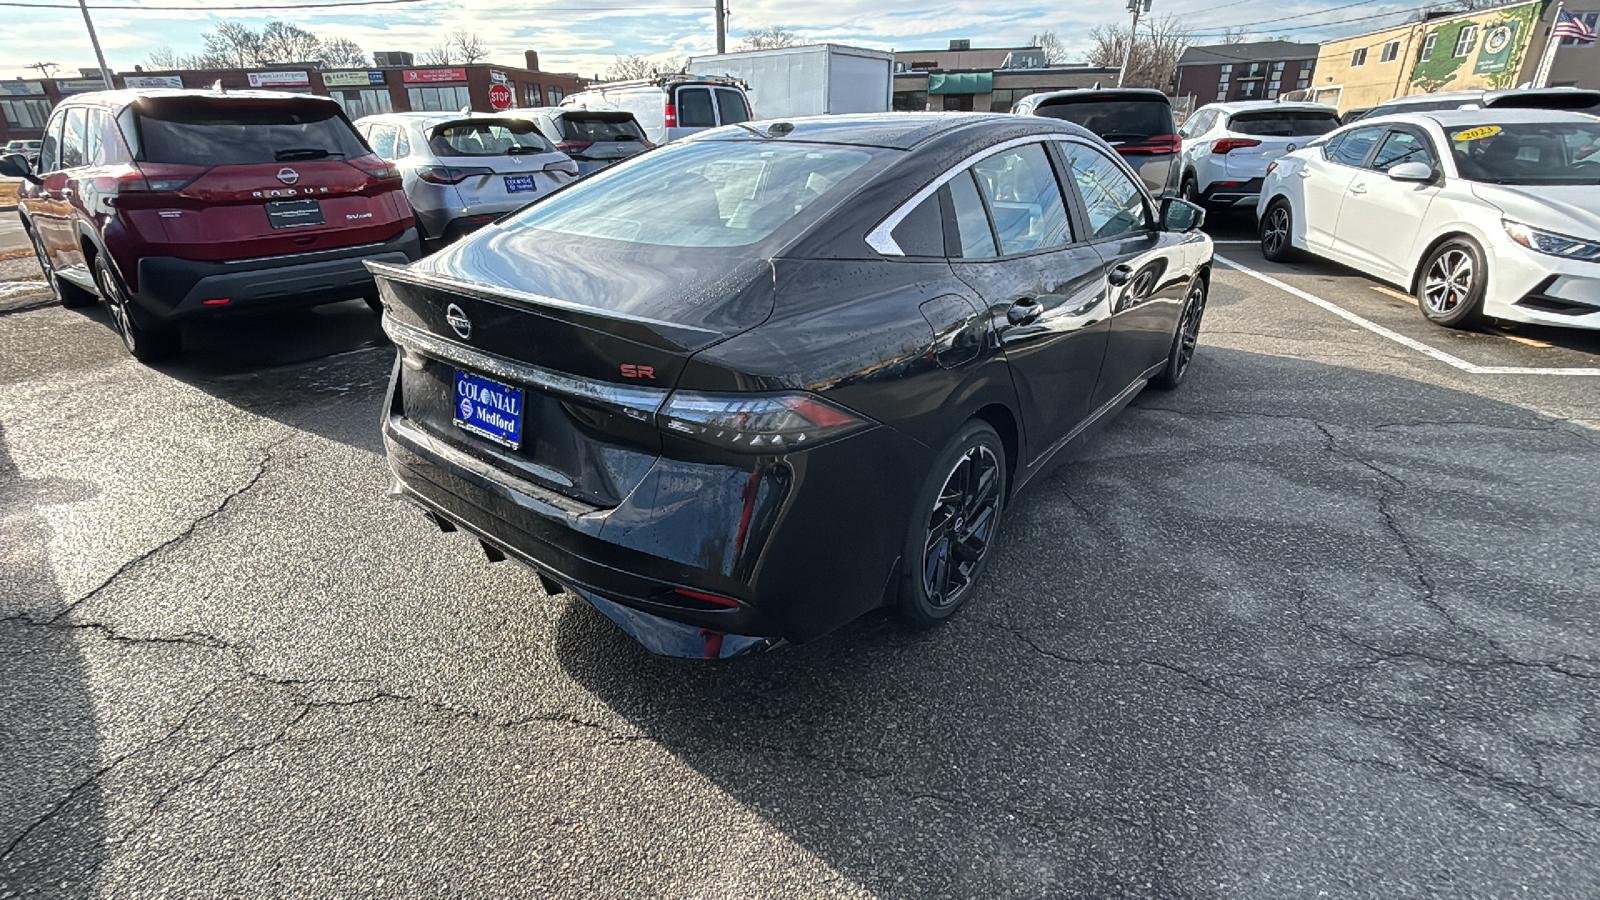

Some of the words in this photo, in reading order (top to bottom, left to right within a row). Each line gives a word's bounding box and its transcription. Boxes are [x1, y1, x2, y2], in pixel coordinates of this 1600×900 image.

[491, 91, 510, 102] STOP
[1463, 127, 1494, 139] 2023
[252, 187, 328, 197] ROGUE
[620, 363, 656, 379] SR
[457, 380, 519, 416] COLONIAL
[476, 406, 515, 433] Medford
